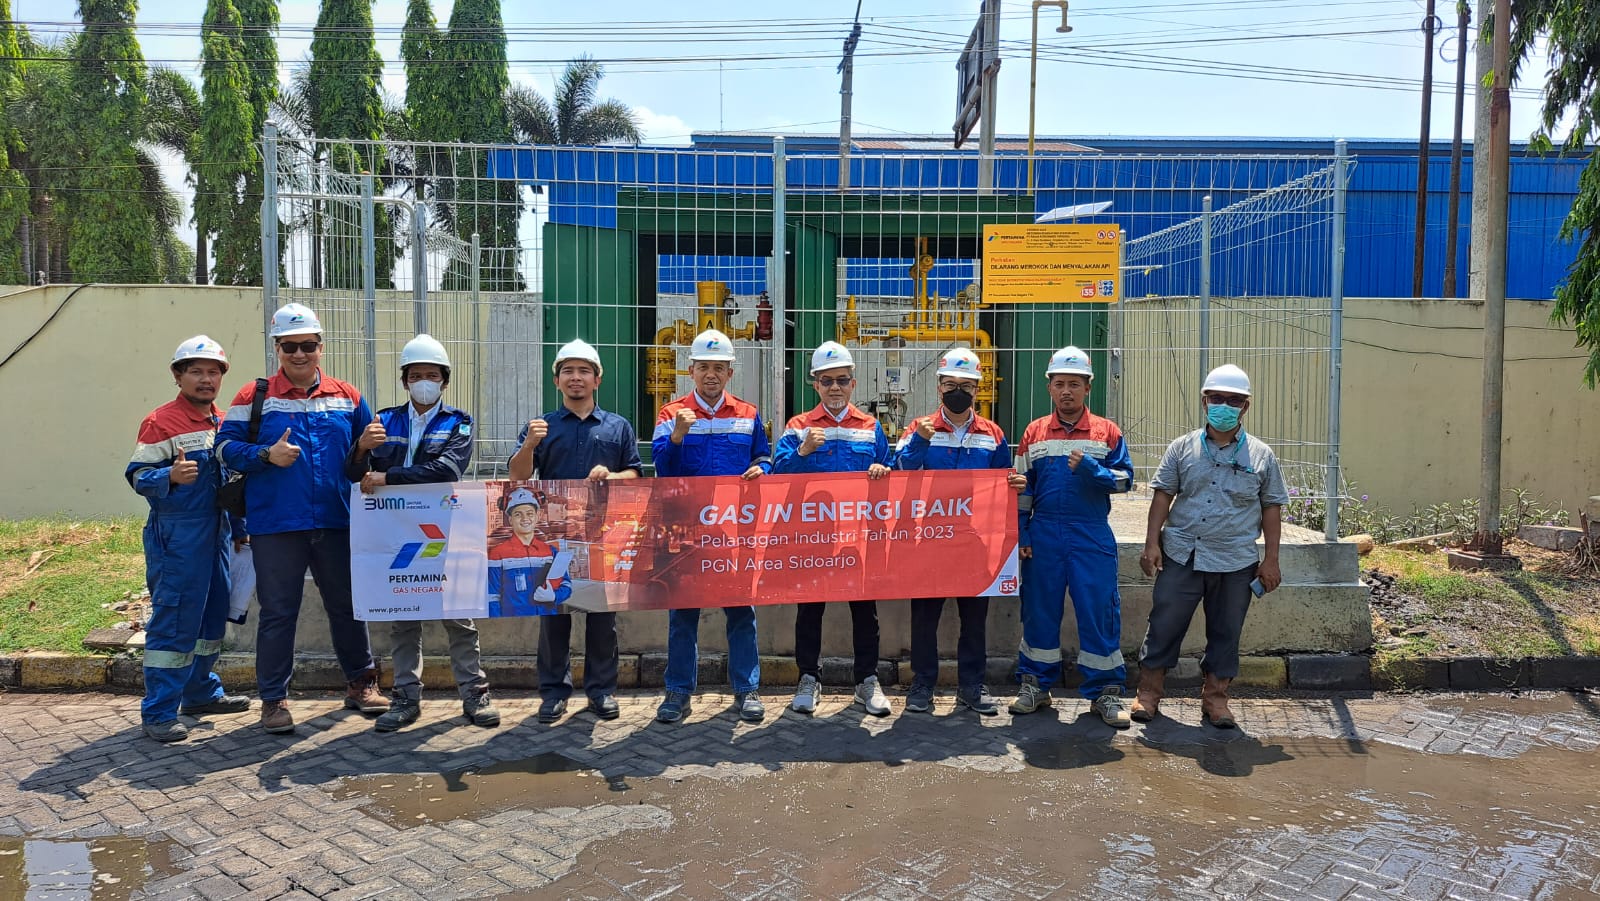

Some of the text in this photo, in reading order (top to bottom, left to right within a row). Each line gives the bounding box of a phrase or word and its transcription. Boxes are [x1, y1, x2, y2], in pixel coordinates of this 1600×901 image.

[364, 497, 405, 511] BUMN
[699, 497, 973, 525] GAS IN ENERGI BAIK
[701, 525, 954, 548] Pelanggan Industri Tahun 2023
[701, 554, 856, 573] PGN Area Sidoarjo
[389, 573, 447, 583] PERTAMINA
[411, 586, 444, 594] NEGARA
[368, 606, 420, 614] www.pgn.co.id
